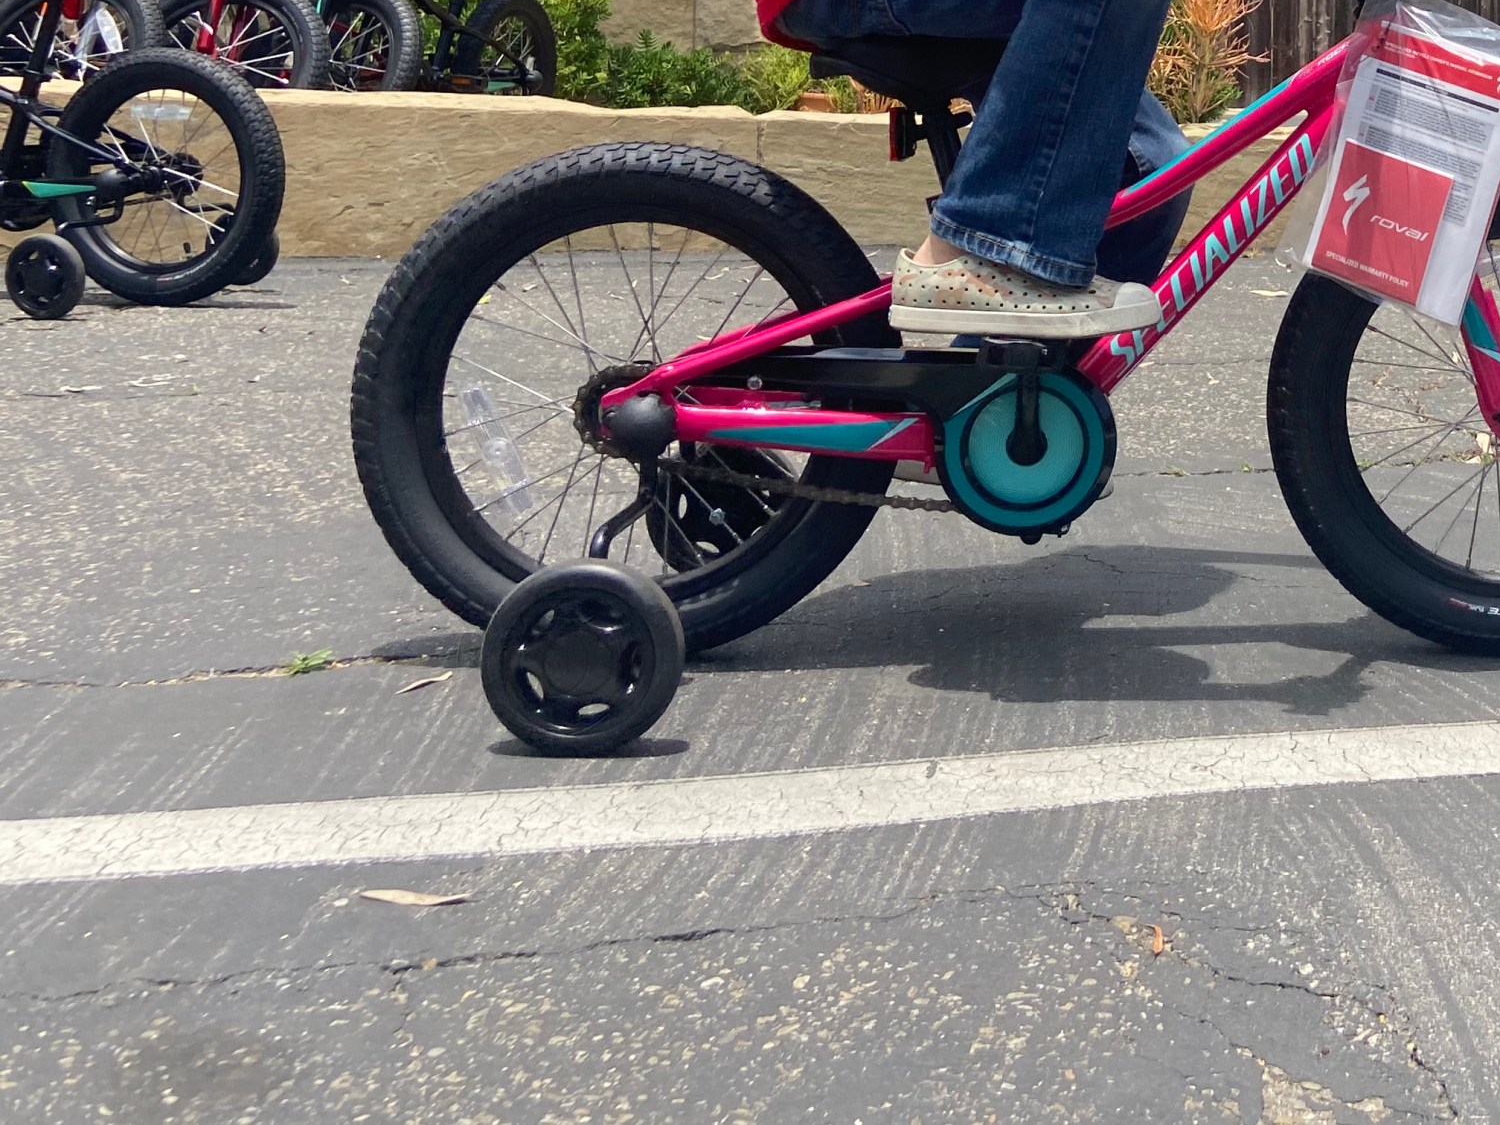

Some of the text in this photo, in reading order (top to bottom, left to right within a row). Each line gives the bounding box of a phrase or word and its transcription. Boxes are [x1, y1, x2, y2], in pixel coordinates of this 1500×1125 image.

[1370, 215, 1429, 241] roval
[1324, 250, 1409, 288] SPECIALIZED WARRANTY POLICY
